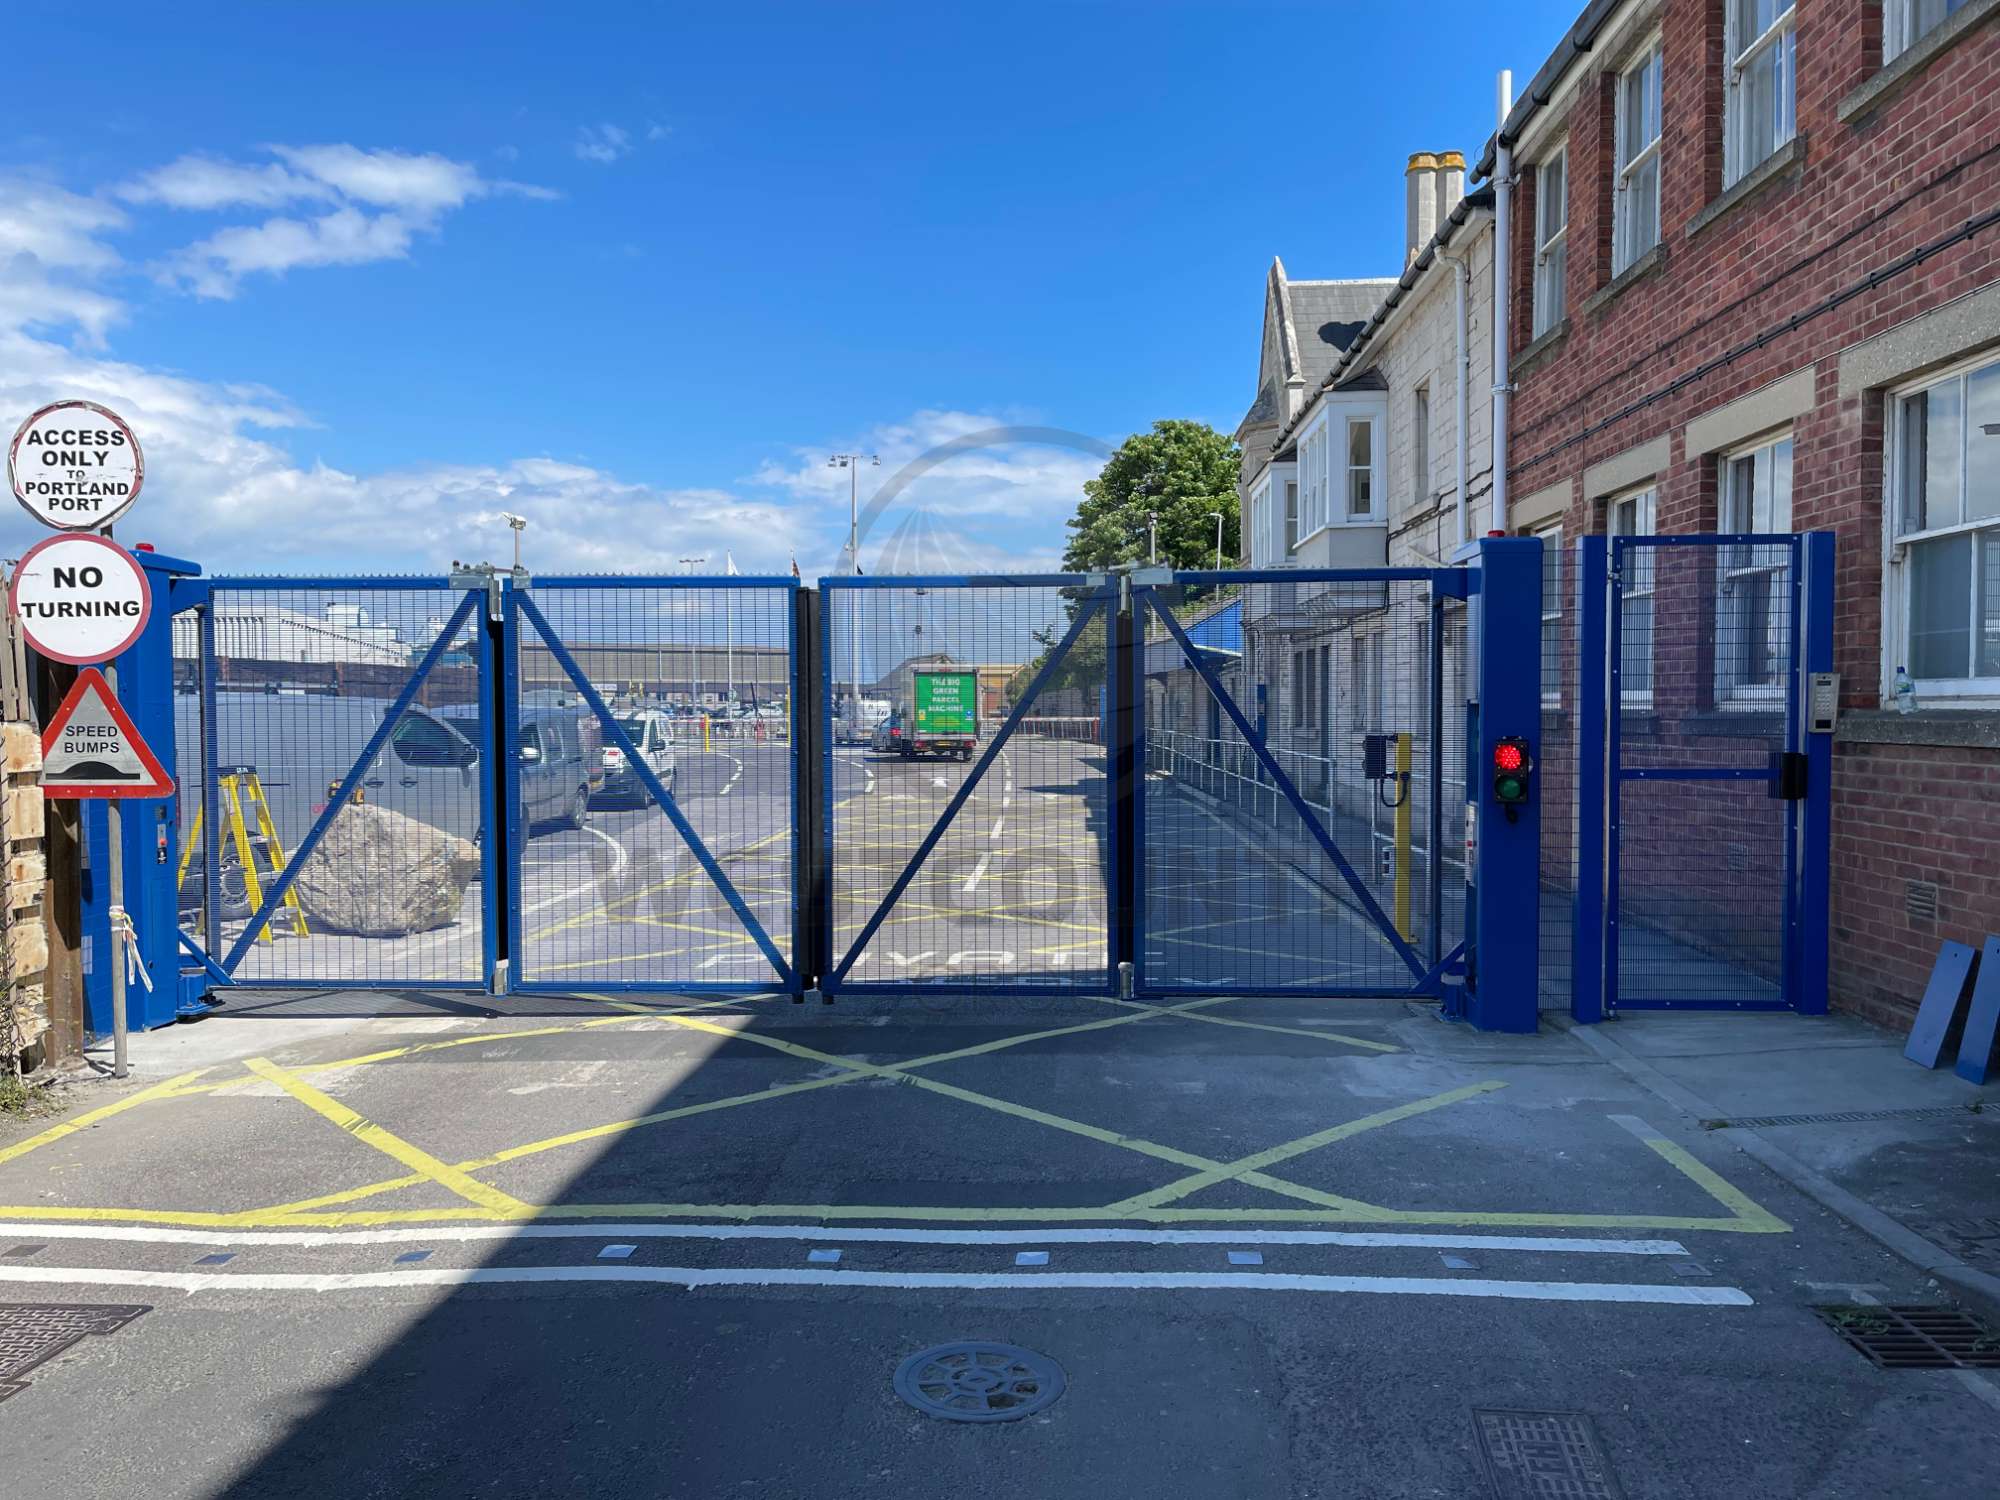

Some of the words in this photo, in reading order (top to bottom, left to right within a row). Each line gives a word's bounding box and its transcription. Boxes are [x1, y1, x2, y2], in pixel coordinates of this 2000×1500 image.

[26, 429, 125, 446] ACCESS
[41, 450, 109, 467] ONLY
[66, 469, 86, 479] TO
[25, 481, 129, 496] PORTLAND
[48, 497, 103, 511] PORT
[53, 566, 103, 588] NO
[21, 600, 140, 618] TURNING
[65, 725, 118, 738] SPEED
[64, 741, 120, 754] BUMPS
